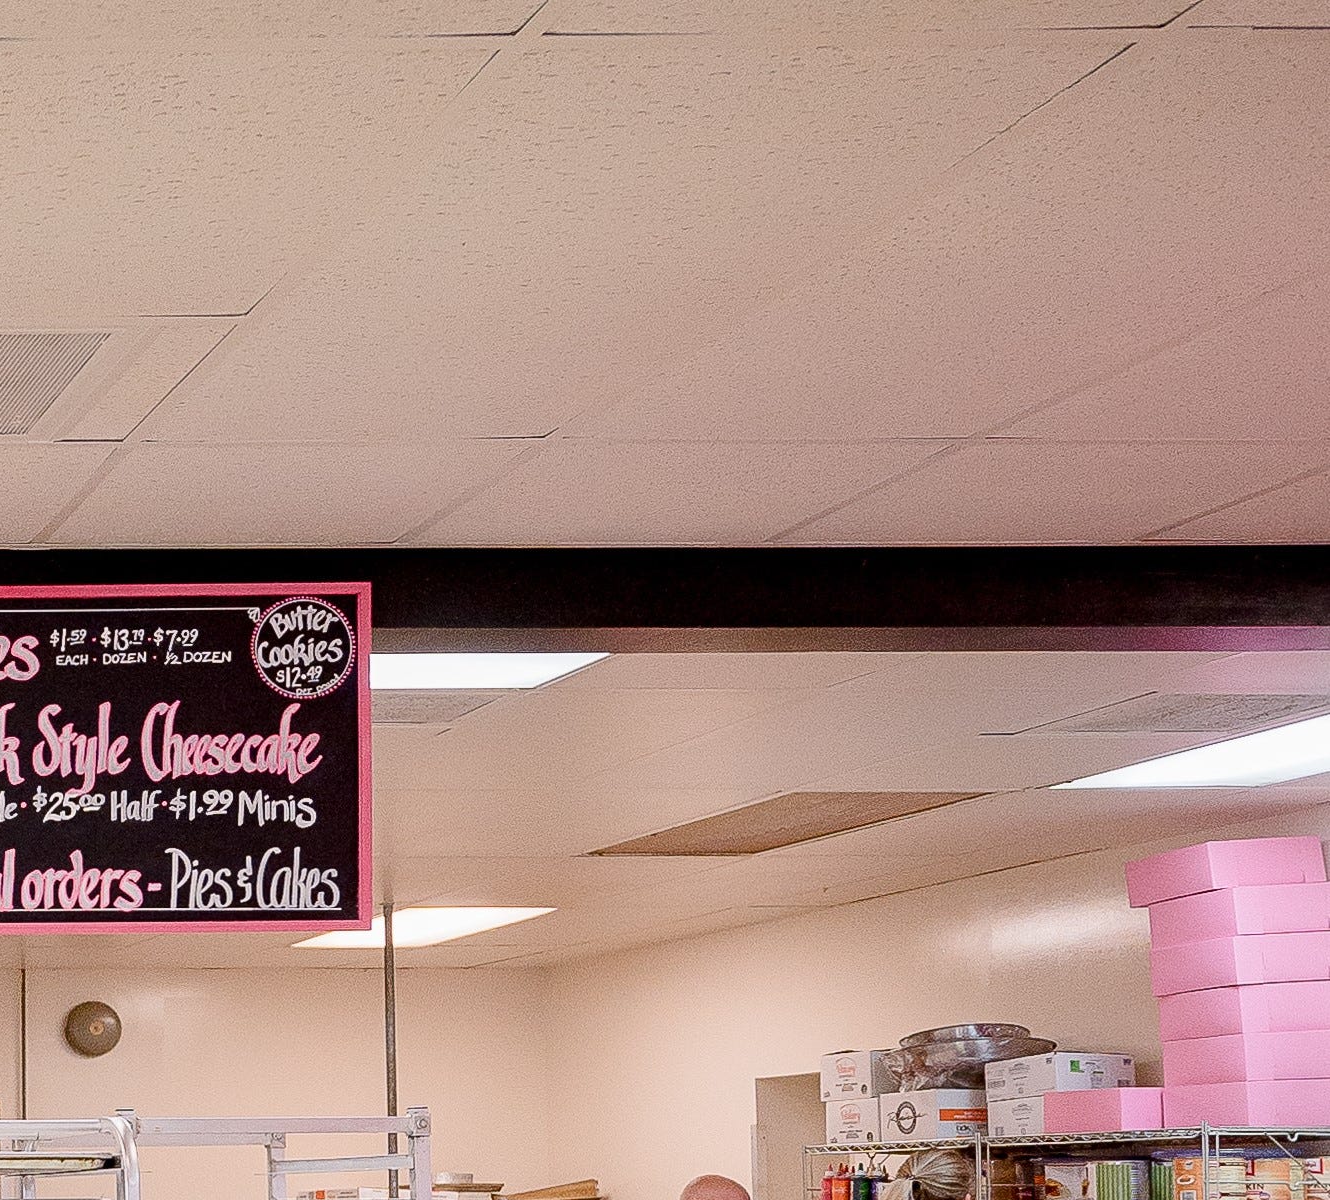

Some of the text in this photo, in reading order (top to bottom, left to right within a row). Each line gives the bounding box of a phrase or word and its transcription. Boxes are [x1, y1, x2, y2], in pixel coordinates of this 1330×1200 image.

[268, 604, 340, 639] Butter
[49, 628, 87, 652] $1.59
[153, 626, 199, 654] $7.99
[55, 654, 89, 666] EACH
[102, 651, 147, 665] DOZEN
[183, 650, 232, 664] DOZEN
[257, 633, 344, 669] Cookies
[32, 702, 132, 796] Style
[141, 700, 324, 784] Cheesecake
[32, 785, 106, 824] $25.00
[111, 789, 160, 824] Half
[169, 789, 234, 819] $1.99
[238, 790, 317, 828] Minis
[21, 849, 145, 912] orders
[165, 847, 233, 909] Pies
[256, 845, 340, 910] Cakes
